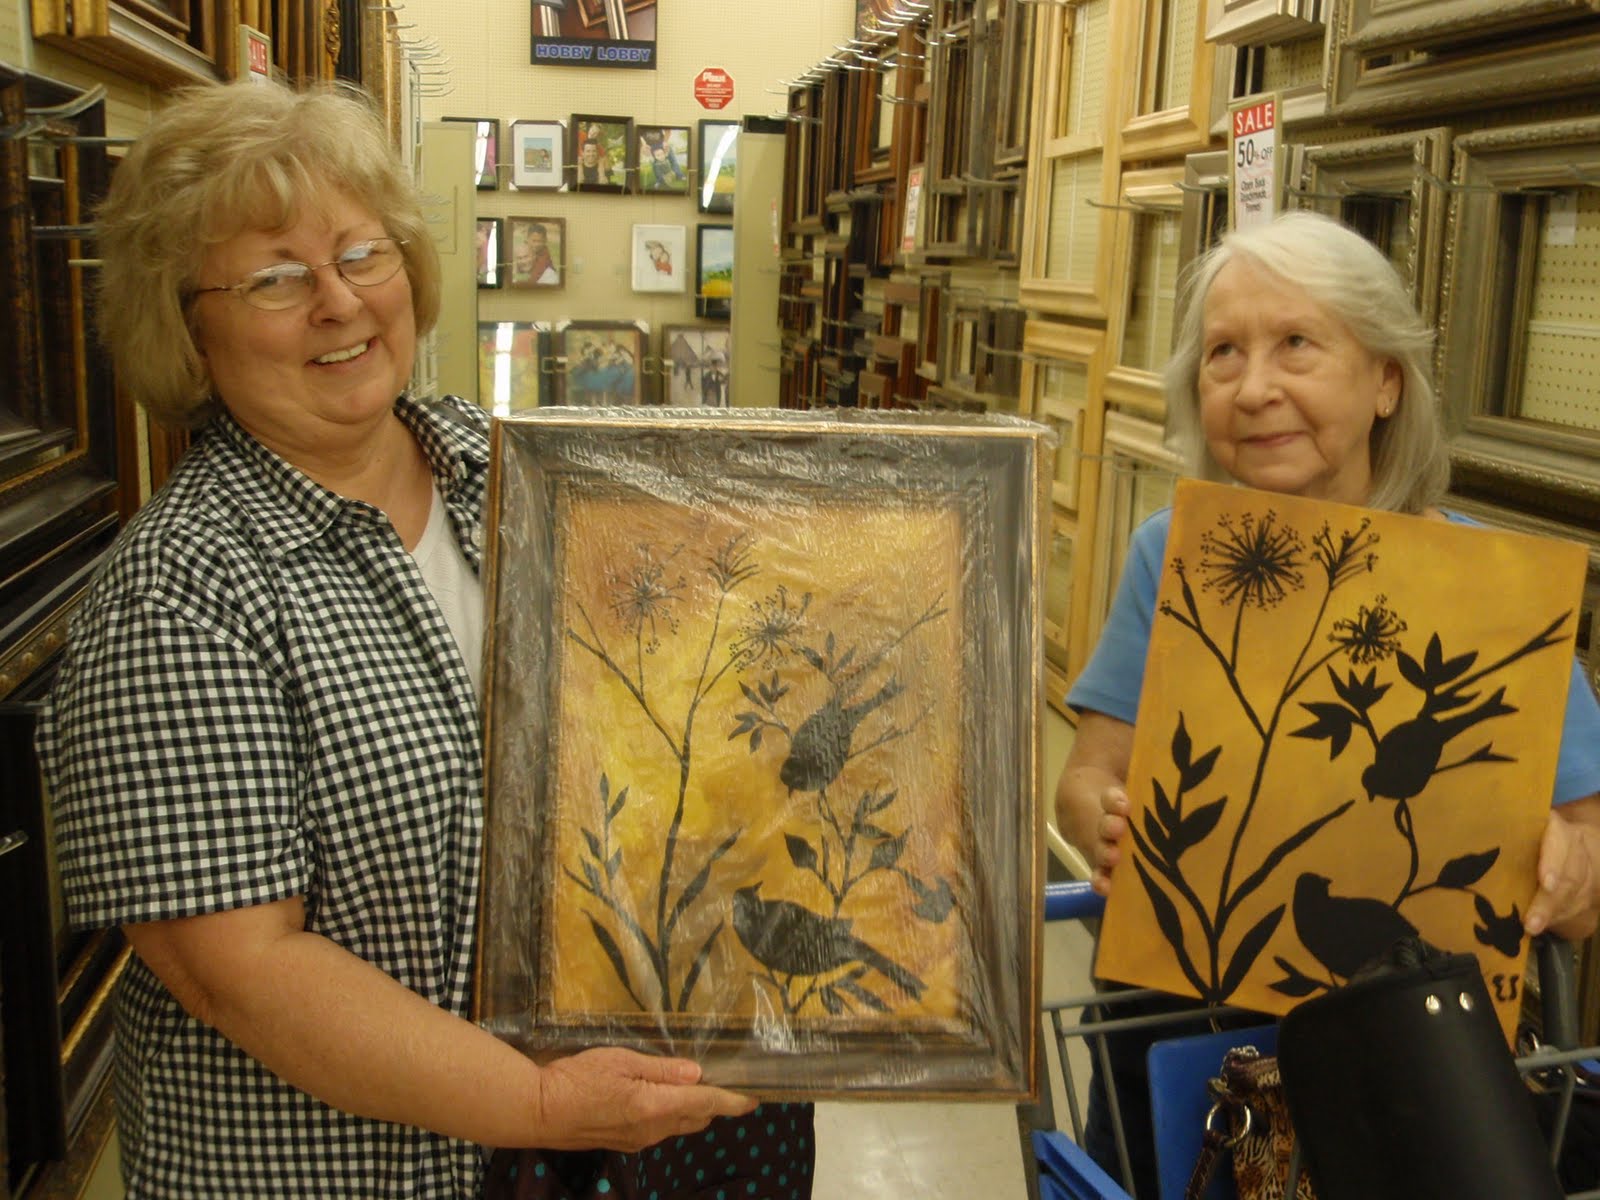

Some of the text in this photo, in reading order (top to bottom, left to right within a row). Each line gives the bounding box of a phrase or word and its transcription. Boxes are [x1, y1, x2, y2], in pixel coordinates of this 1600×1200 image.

[536, 44, 651, 62] HOBBY LOBBY
[1236, 103, 1273, 135] SALE
[1260, 146, 1273, 160] OFF
